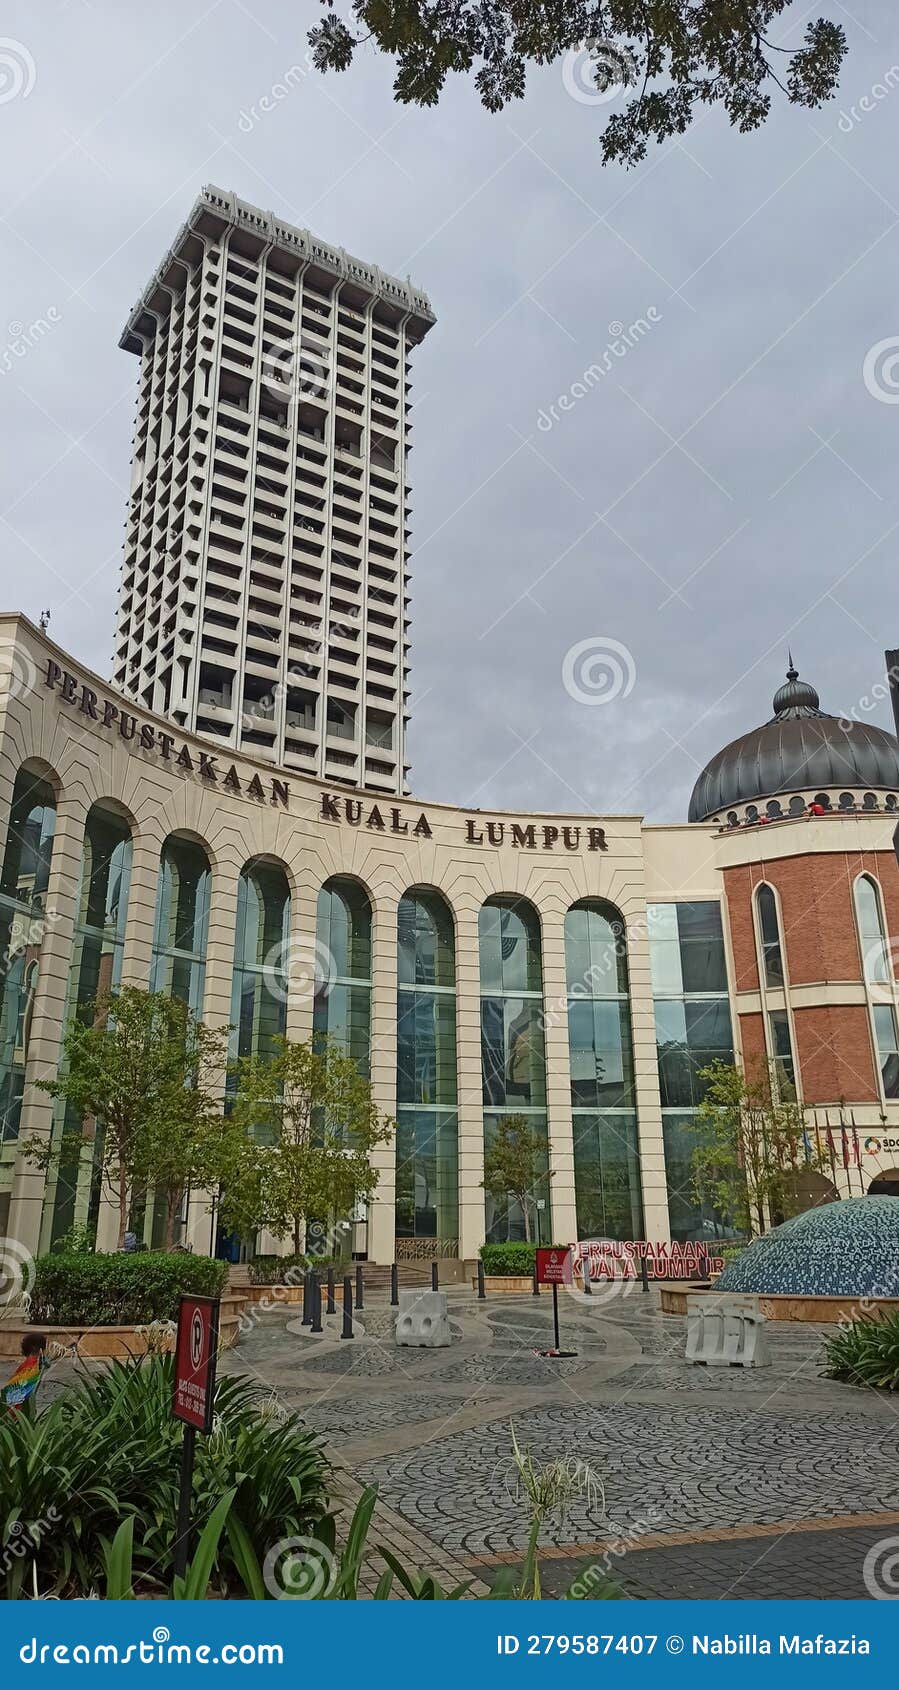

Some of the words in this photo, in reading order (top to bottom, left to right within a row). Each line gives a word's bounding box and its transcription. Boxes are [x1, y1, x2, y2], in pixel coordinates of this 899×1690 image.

[43, 658, 290, 803] PERPUSTAKAAN
[320, 792, 433, 836] KUALA
[465, 819, 609, 851] LUMPUR
